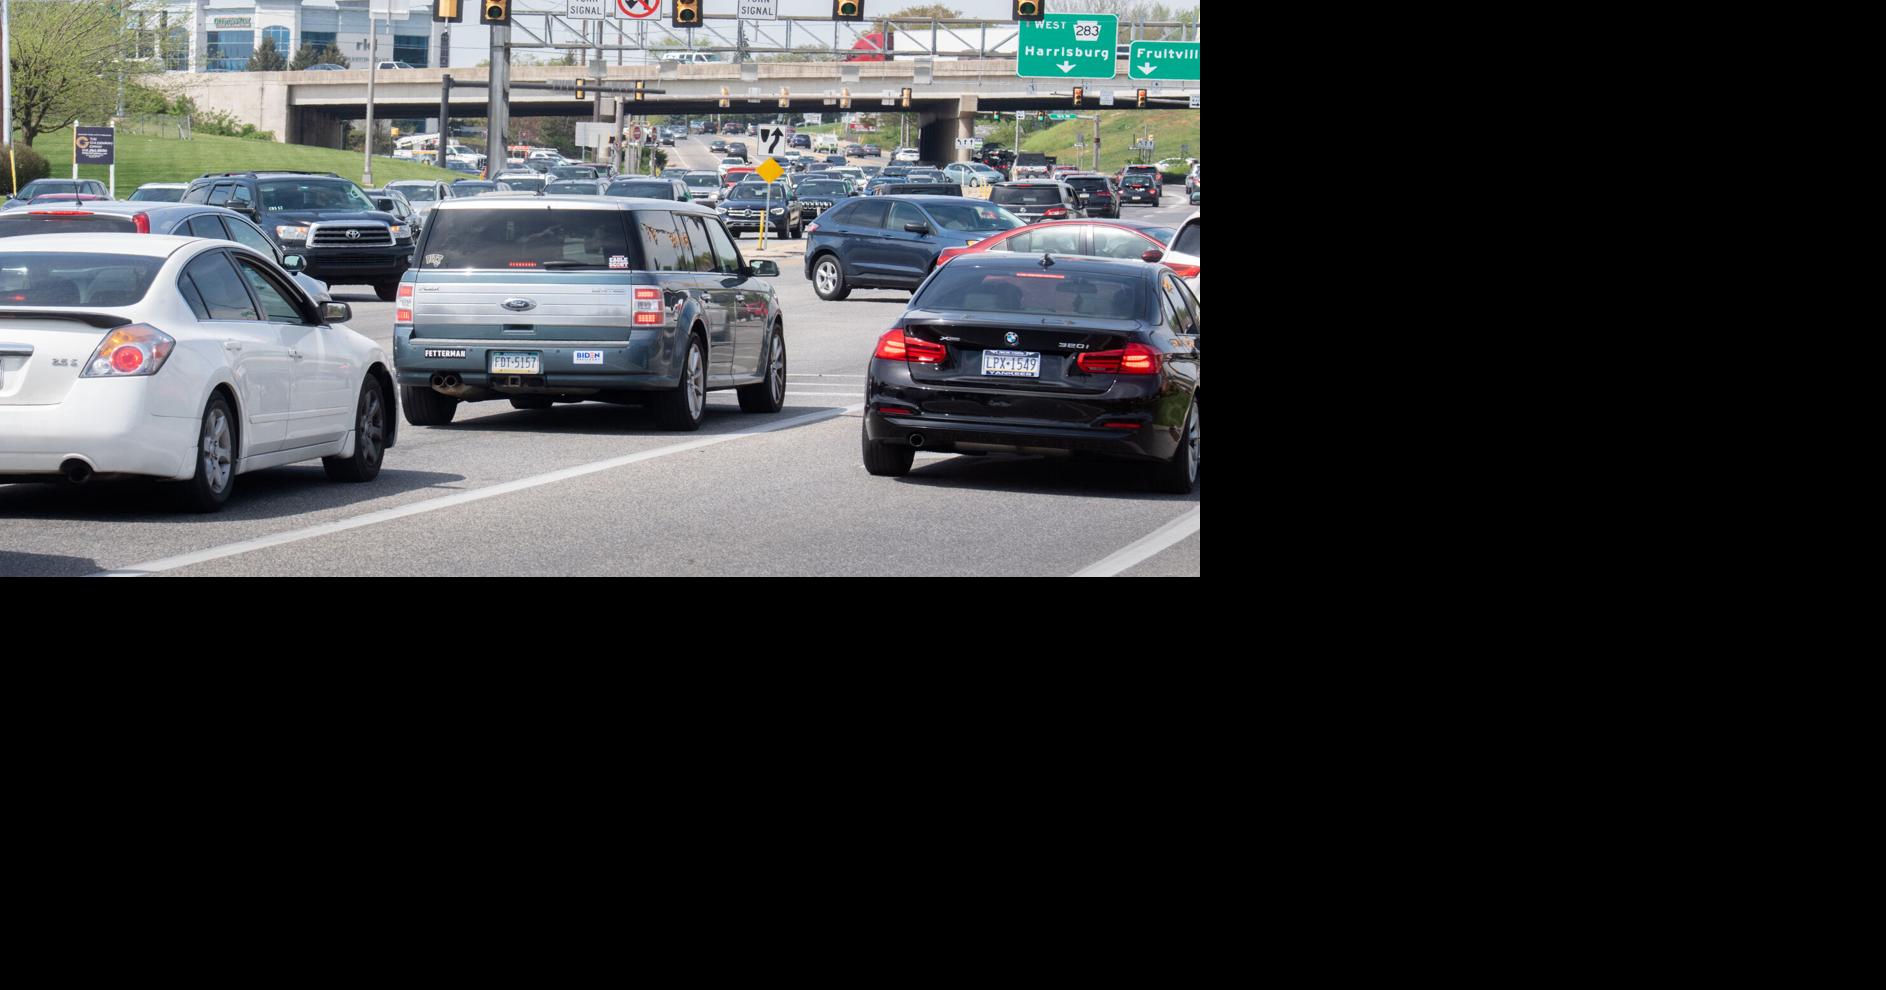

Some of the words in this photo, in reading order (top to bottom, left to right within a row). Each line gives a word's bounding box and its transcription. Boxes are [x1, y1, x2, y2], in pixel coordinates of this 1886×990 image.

[570, 6, 602, 15] SIGNAL
[741, 6, 774, 15] SIGNAL
[1034, 20, 1066, 29] WEST
[1076, 25, 1099, 36] 283
[1025, 45, 1109, 61] Harrisburg
